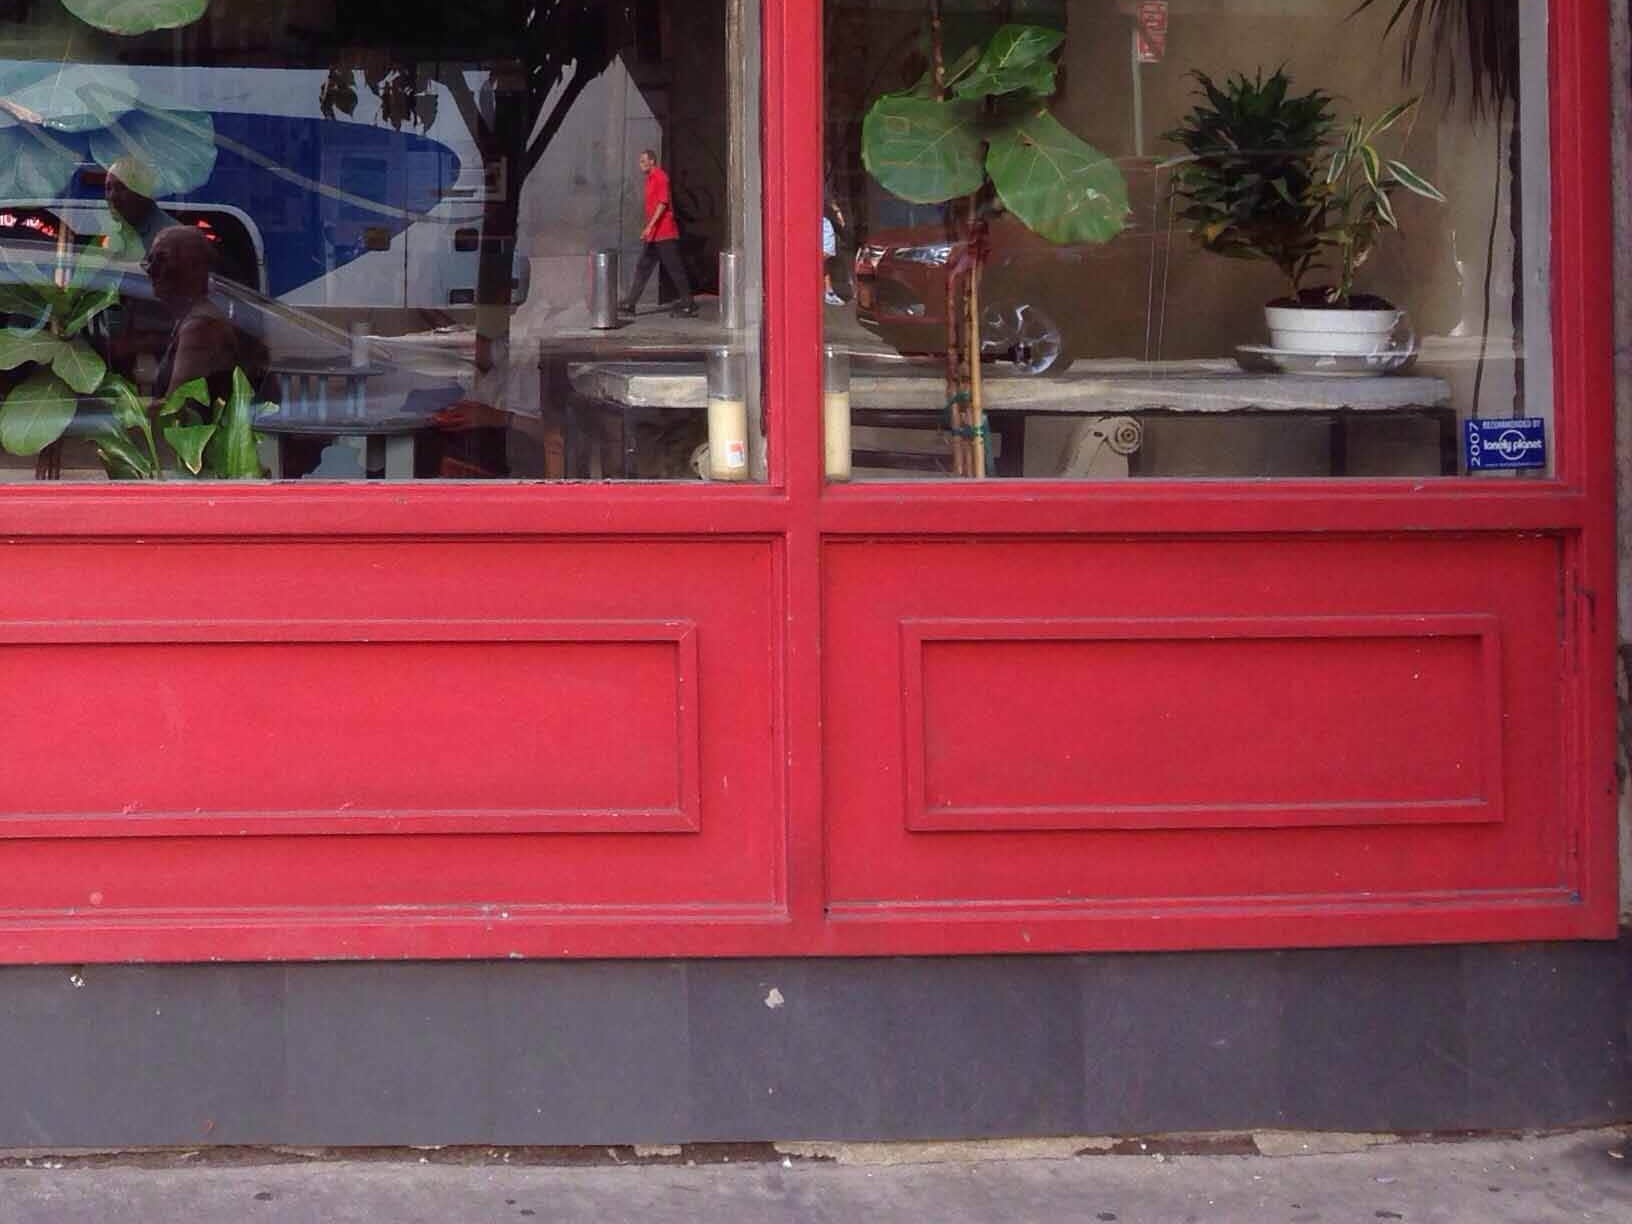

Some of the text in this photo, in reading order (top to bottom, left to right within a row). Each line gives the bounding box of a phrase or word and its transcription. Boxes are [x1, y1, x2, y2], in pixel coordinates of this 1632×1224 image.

[1469, 422, 1481, 467] 2007
[1483, 439, 1543, 453] lonely planet
